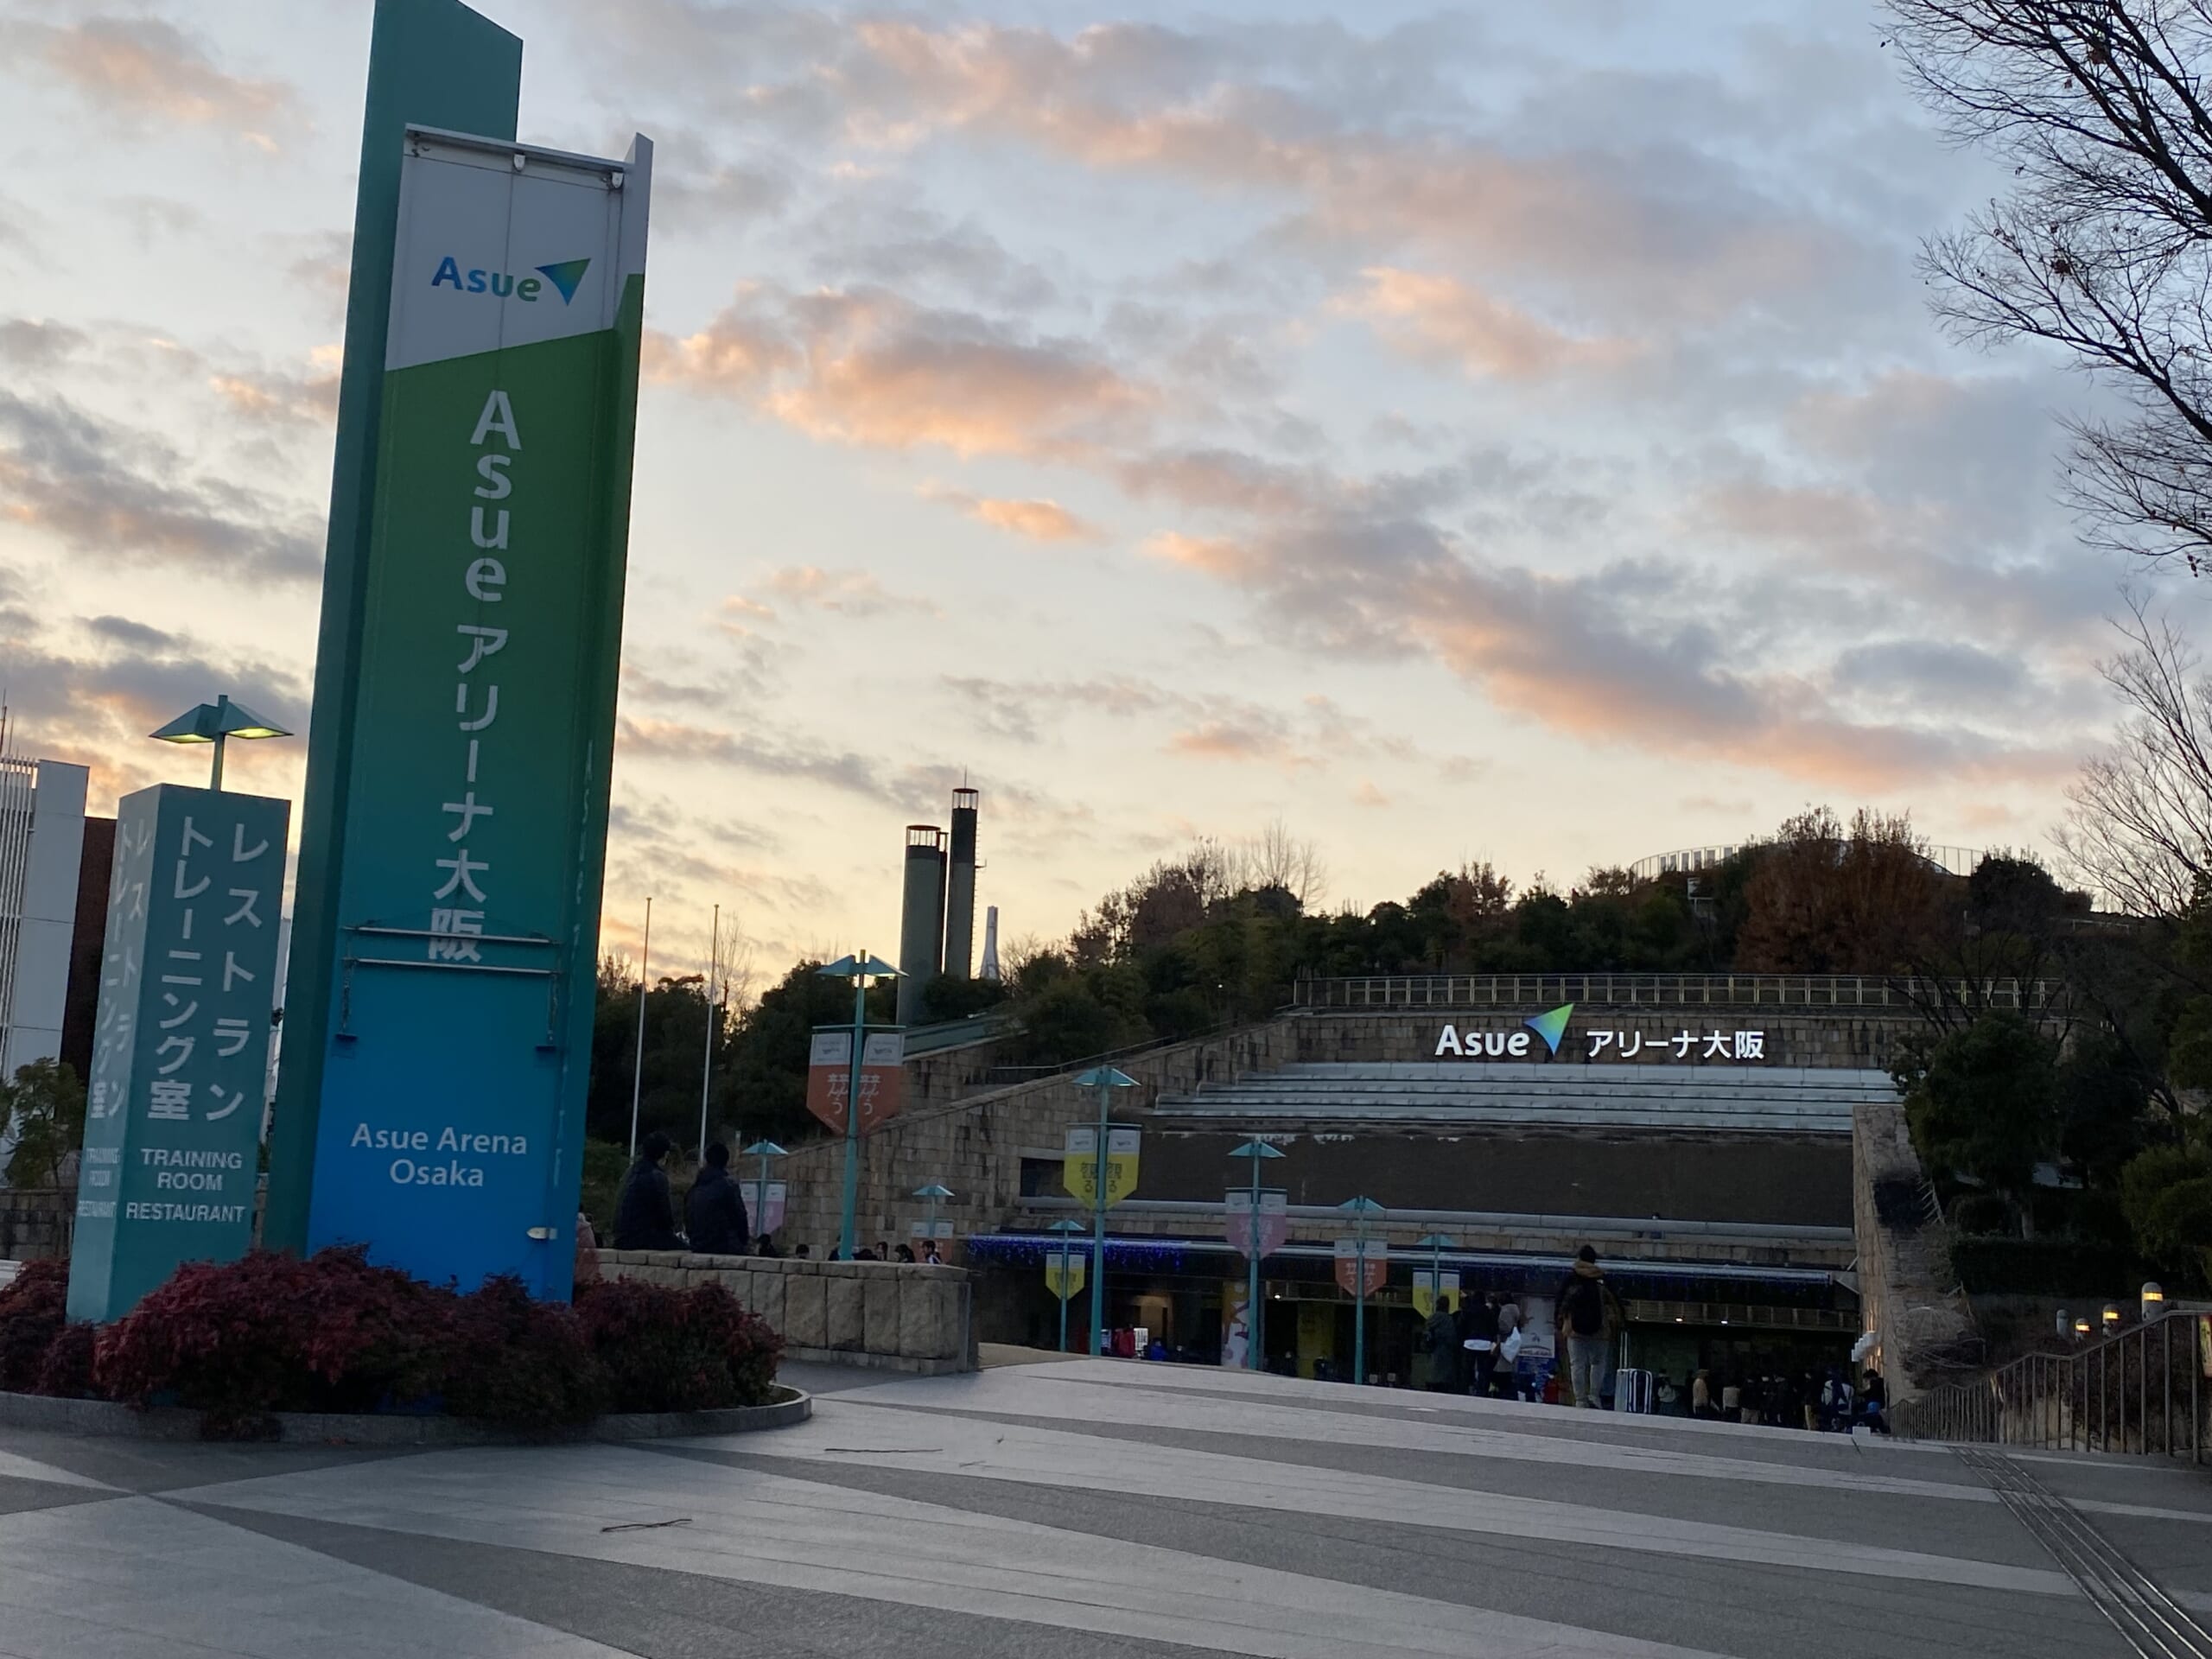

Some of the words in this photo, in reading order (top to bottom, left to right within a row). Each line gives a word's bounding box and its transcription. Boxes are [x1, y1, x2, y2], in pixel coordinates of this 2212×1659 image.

[431, 257, 542, 302] Asue
[465, 390, 522, 602] Asue
[428, 625, 508, 962] アリーナ大阪
[148, 816, 214, 1120] トレーニング室
[206, 823, 270, 1121] レストラン
[1435, 1025, 1530, 1056] Asue
[1586, 1030, 1765, 1059] アリーナ大阪
[351, 1123, 429, 1150] Asue
[436, 1127, 527, 1154] Arena
[141, 1148, 243, 1169] TRAINING
[390, 1159, 484, 1186] Osaka
[157, 1173, 223, 1191] ROOM
[125, 1202, 245, 1223] RESTAURANT
